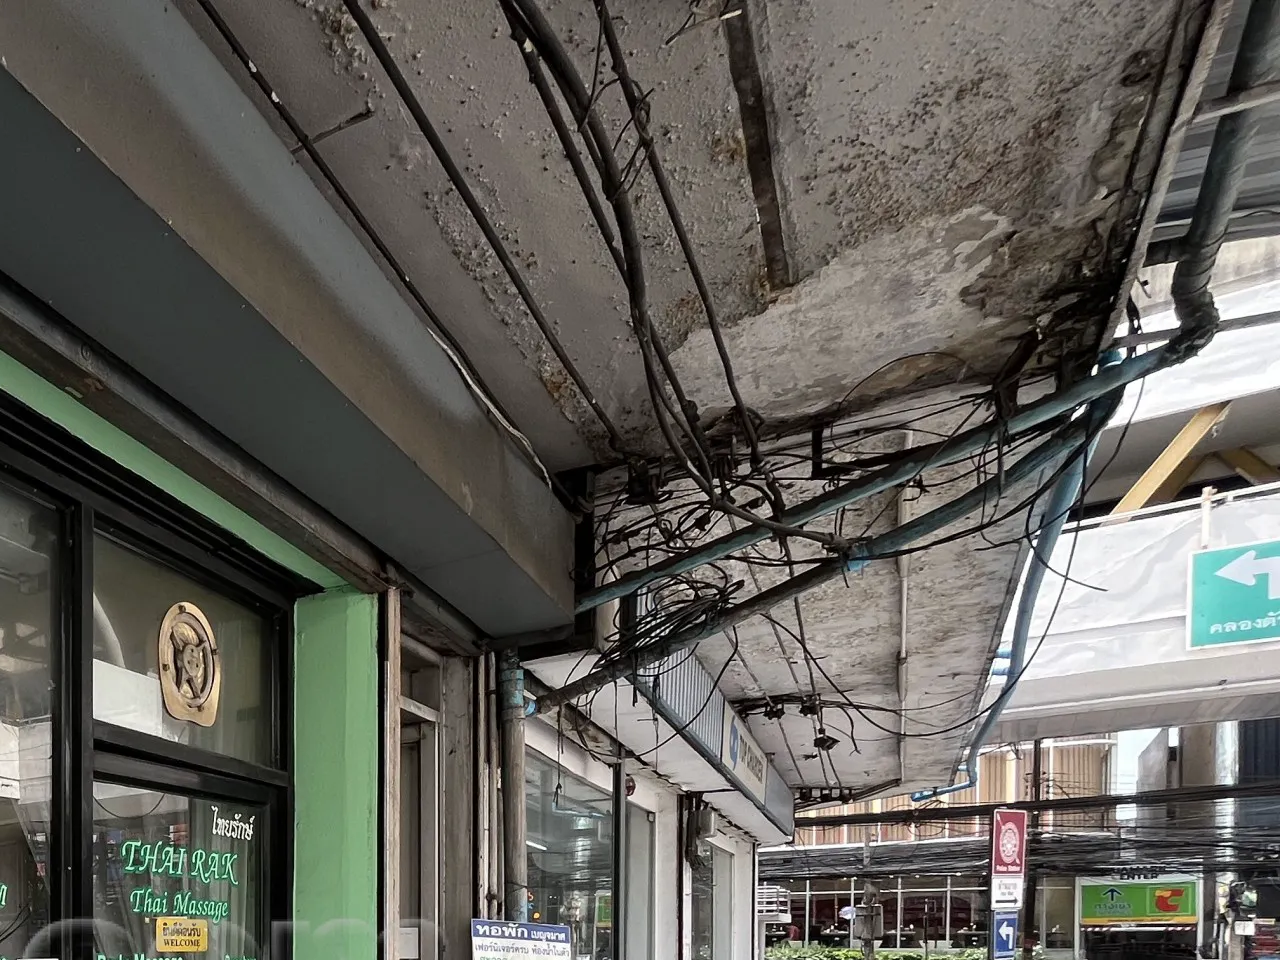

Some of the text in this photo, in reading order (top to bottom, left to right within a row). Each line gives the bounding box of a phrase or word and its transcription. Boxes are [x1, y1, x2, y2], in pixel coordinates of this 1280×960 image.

[122, 840, 238, 884] THAI RAK
[130, 889, 228, 923] Thai Massage
